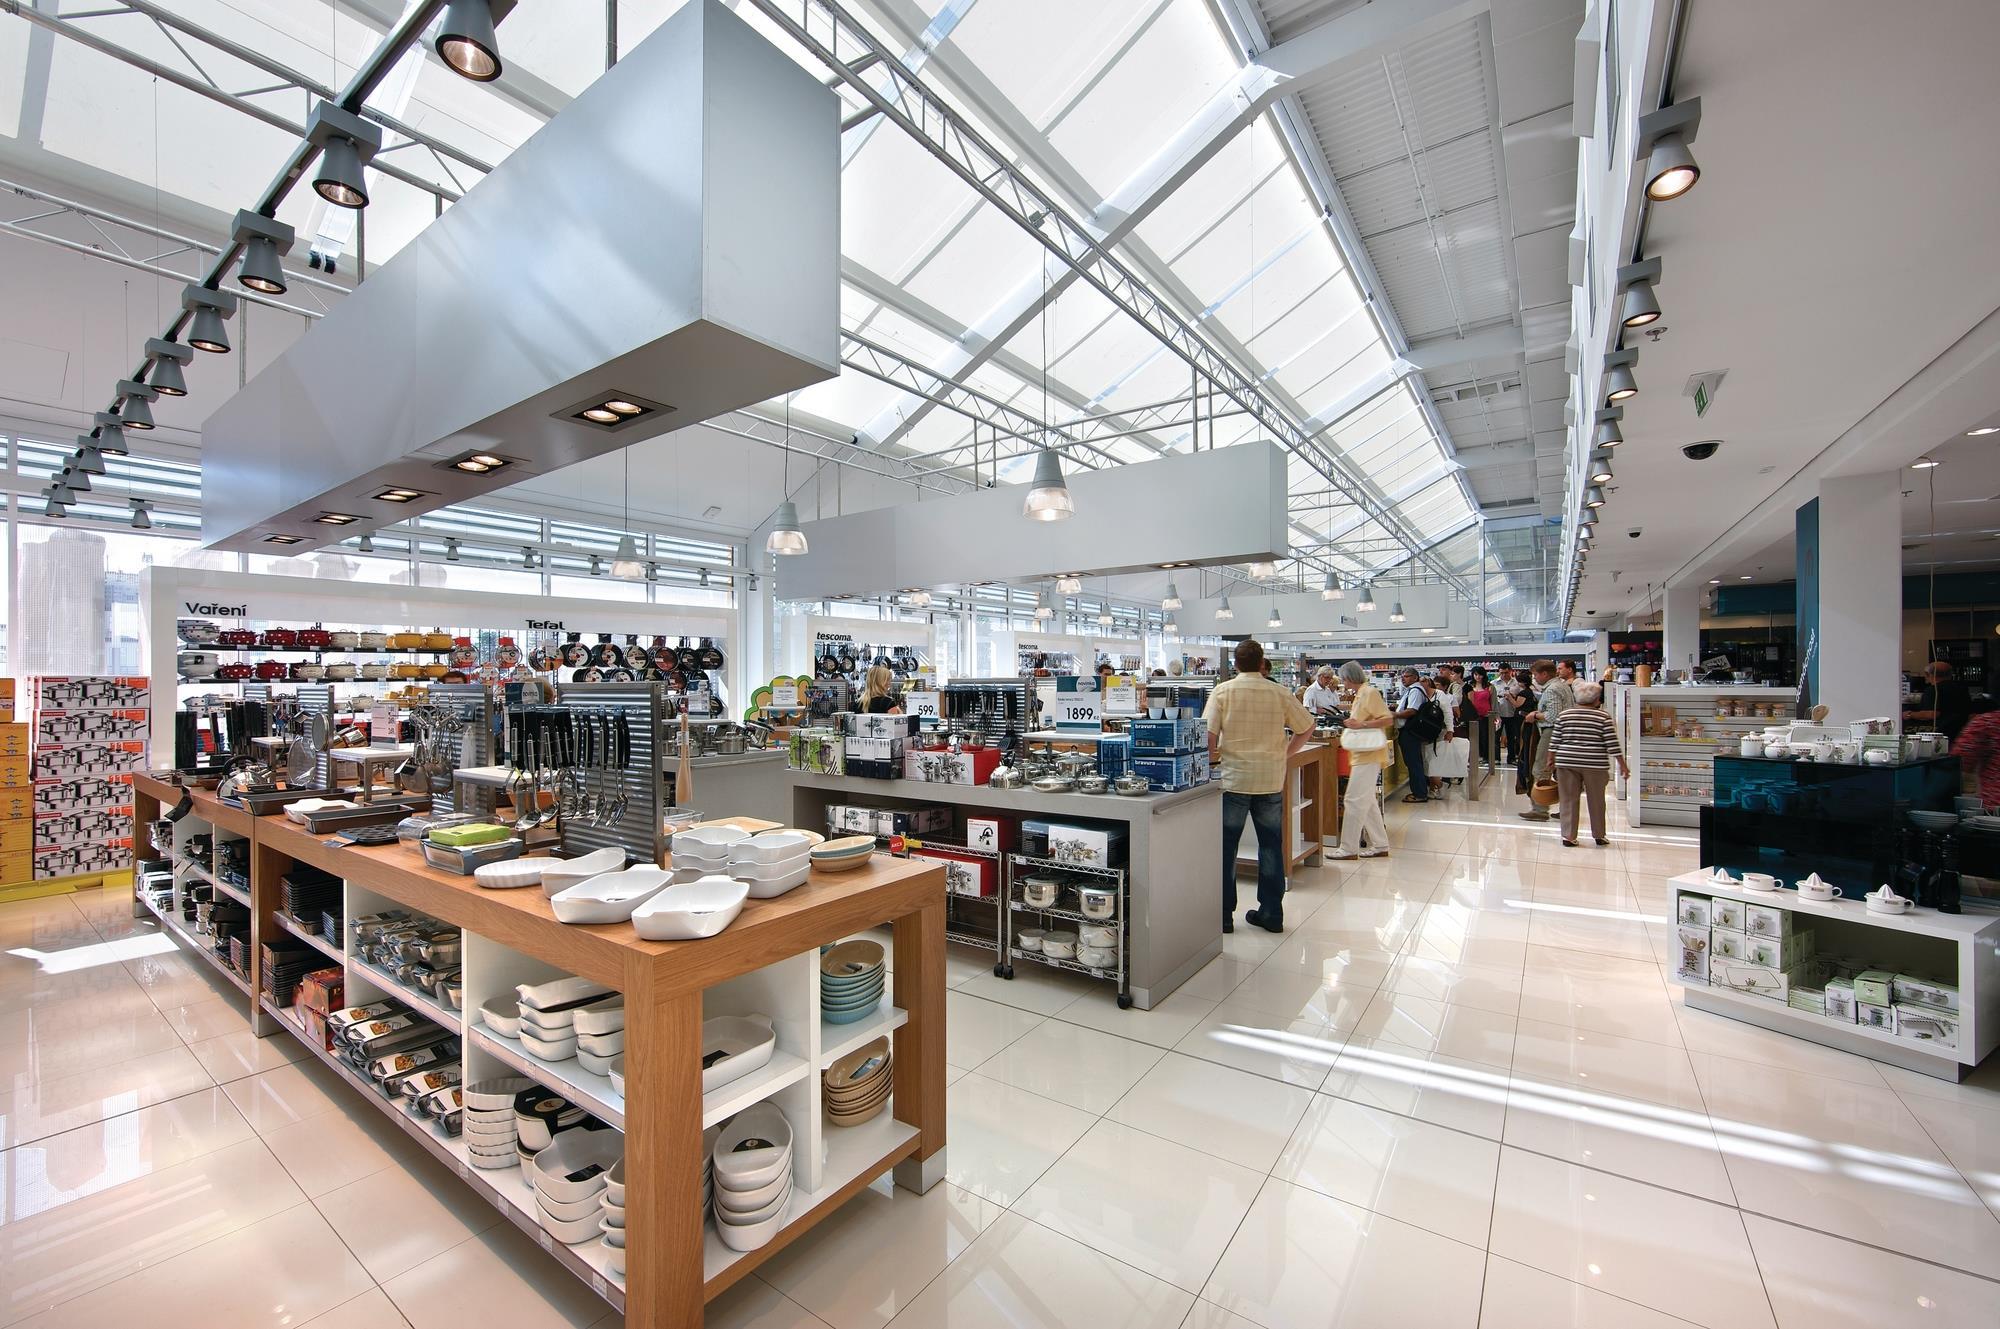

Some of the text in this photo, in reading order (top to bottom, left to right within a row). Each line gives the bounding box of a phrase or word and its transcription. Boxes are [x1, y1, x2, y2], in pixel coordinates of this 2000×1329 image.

[185, 602, 247, 617] Vaření
[525, 619, 566, 631] Tefal
[918, 704, 934, 716] 599
[1066, 707, 1094, 720] 1899
